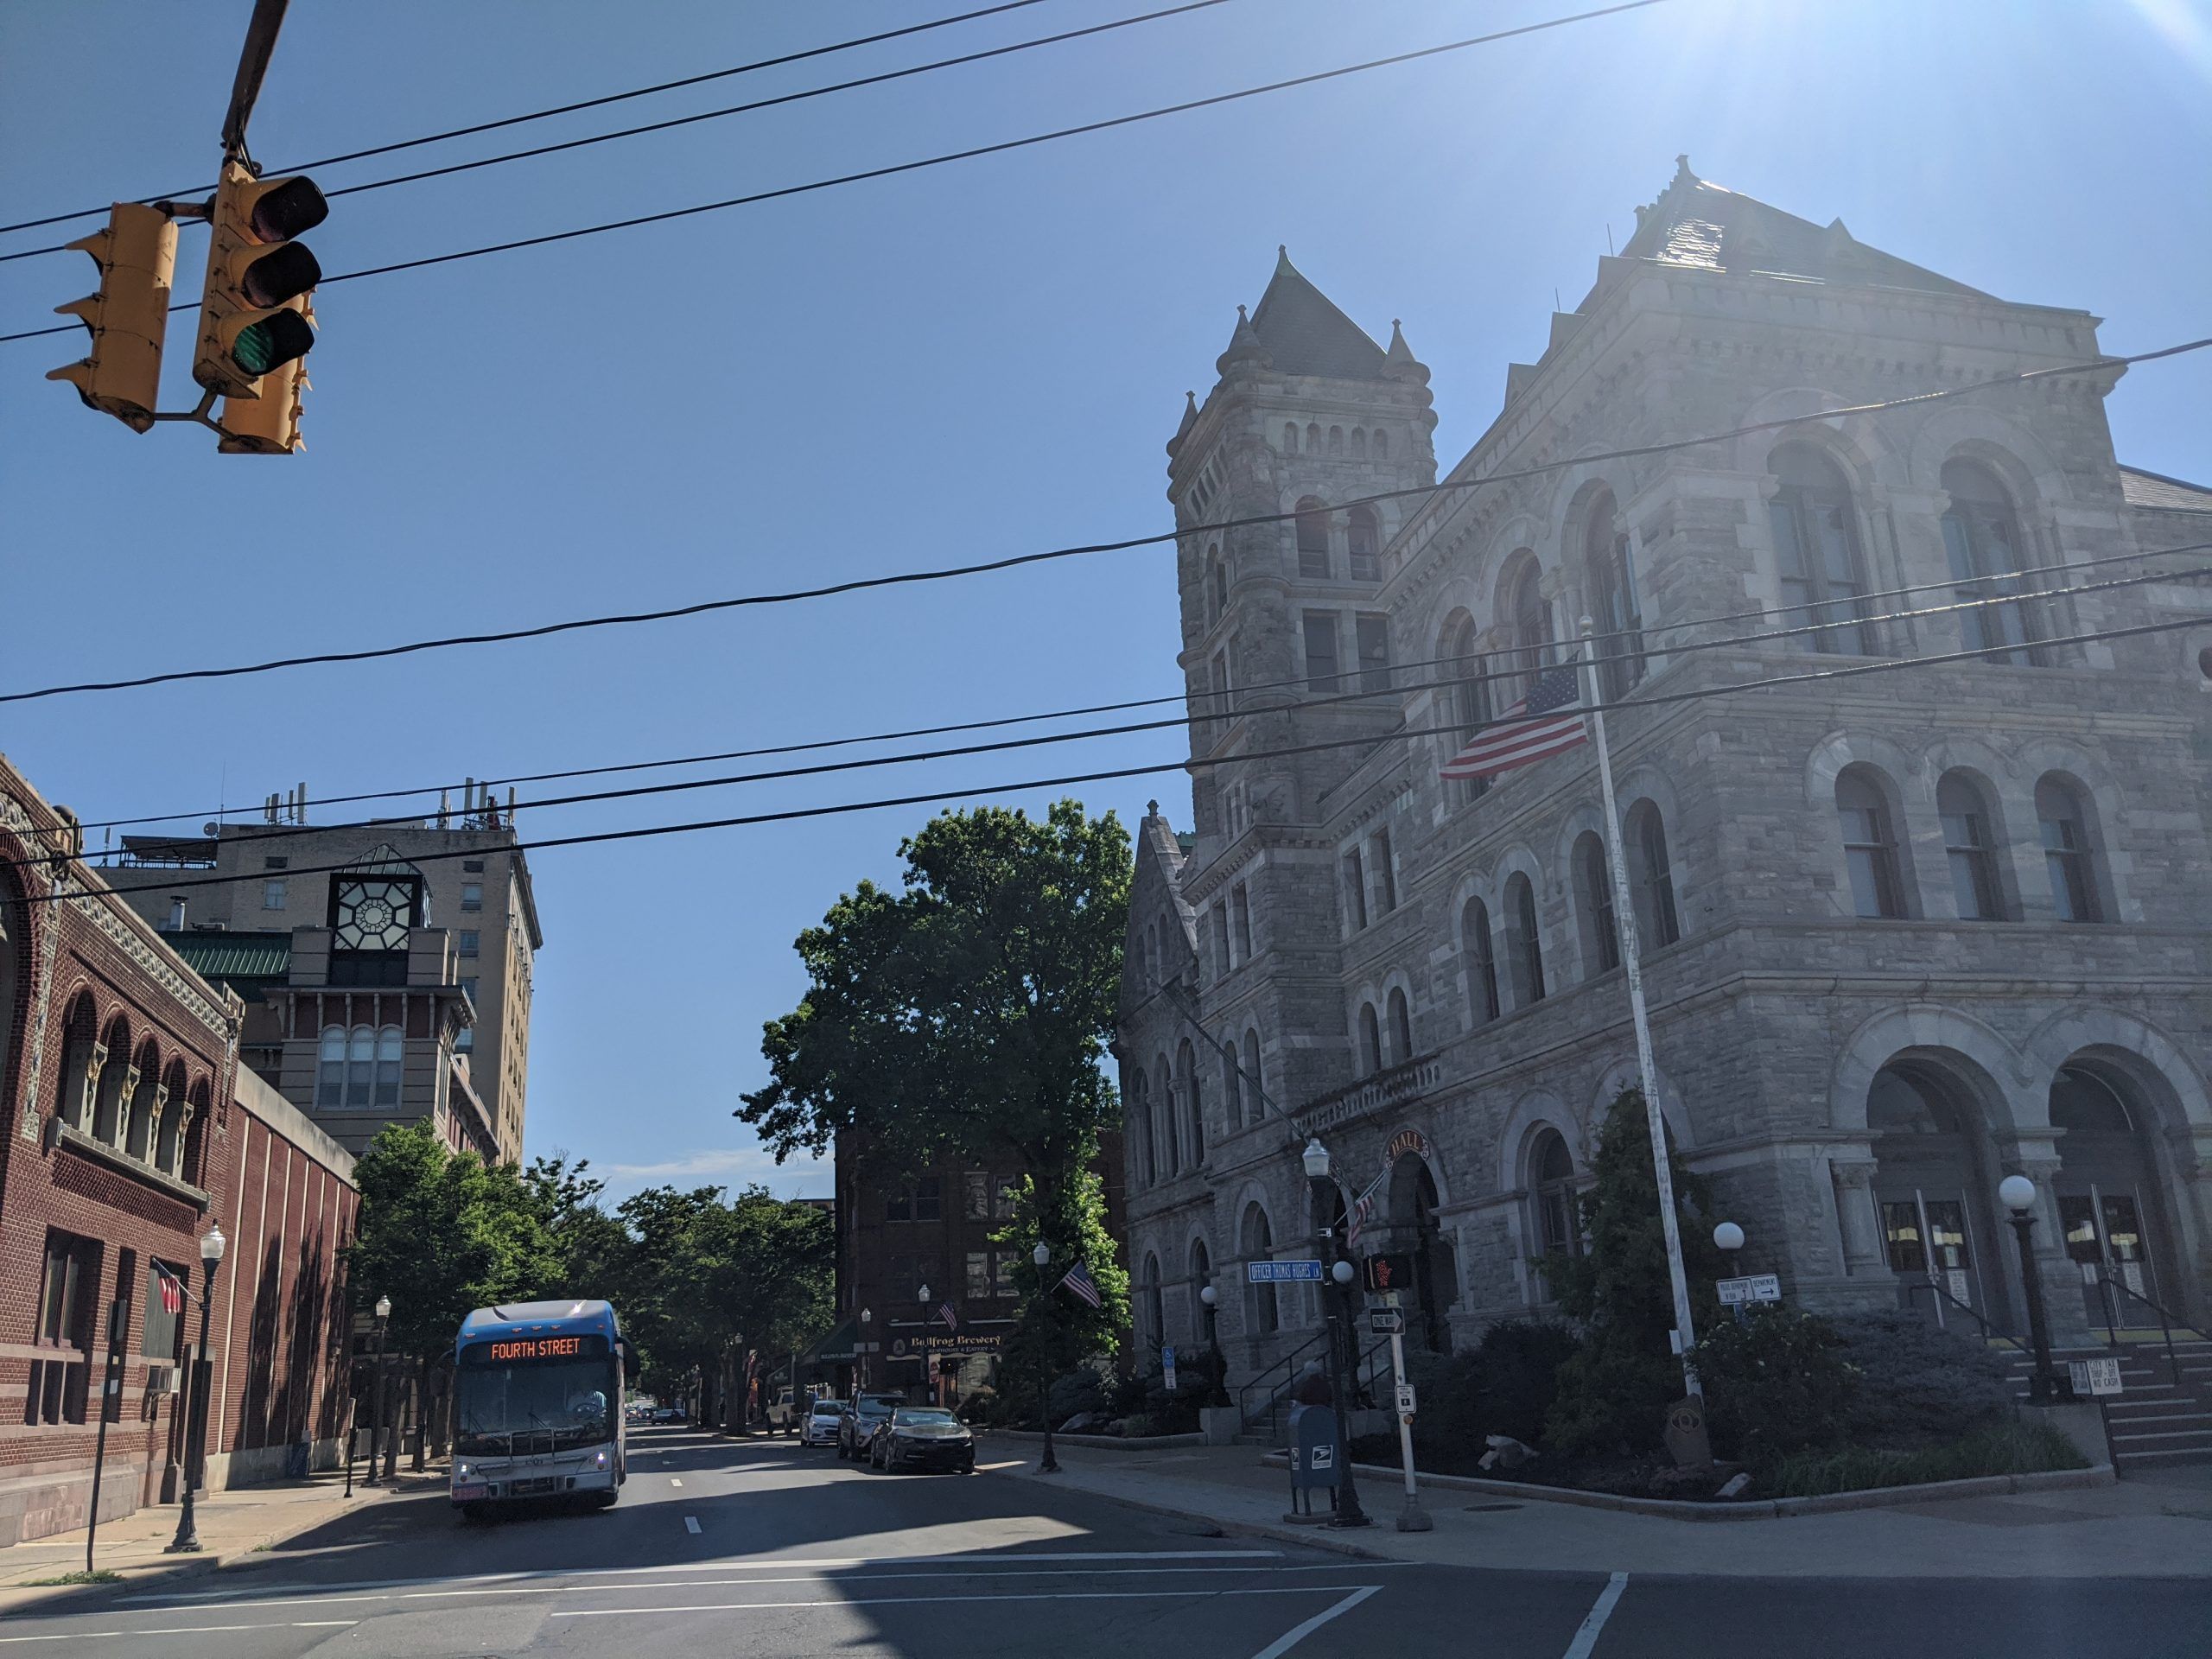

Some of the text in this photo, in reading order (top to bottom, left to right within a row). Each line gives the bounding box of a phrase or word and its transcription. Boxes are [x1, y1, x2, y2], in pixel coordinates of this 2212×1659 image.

[1391, 1132, 1419, 1157] HALL
[1251, 1264, 1272, 1280] OFFICER
[1273, 1263, 1291, 1278] THOMAS
[1292, 1262, 1311, 1278] HUGHES
[492, 1338, 580, 1360] FOURTH STREET
[912, 1335, 1001, 1348] Bullfrog Brewery
[2104, 1377, 2118, 1386] CASH
